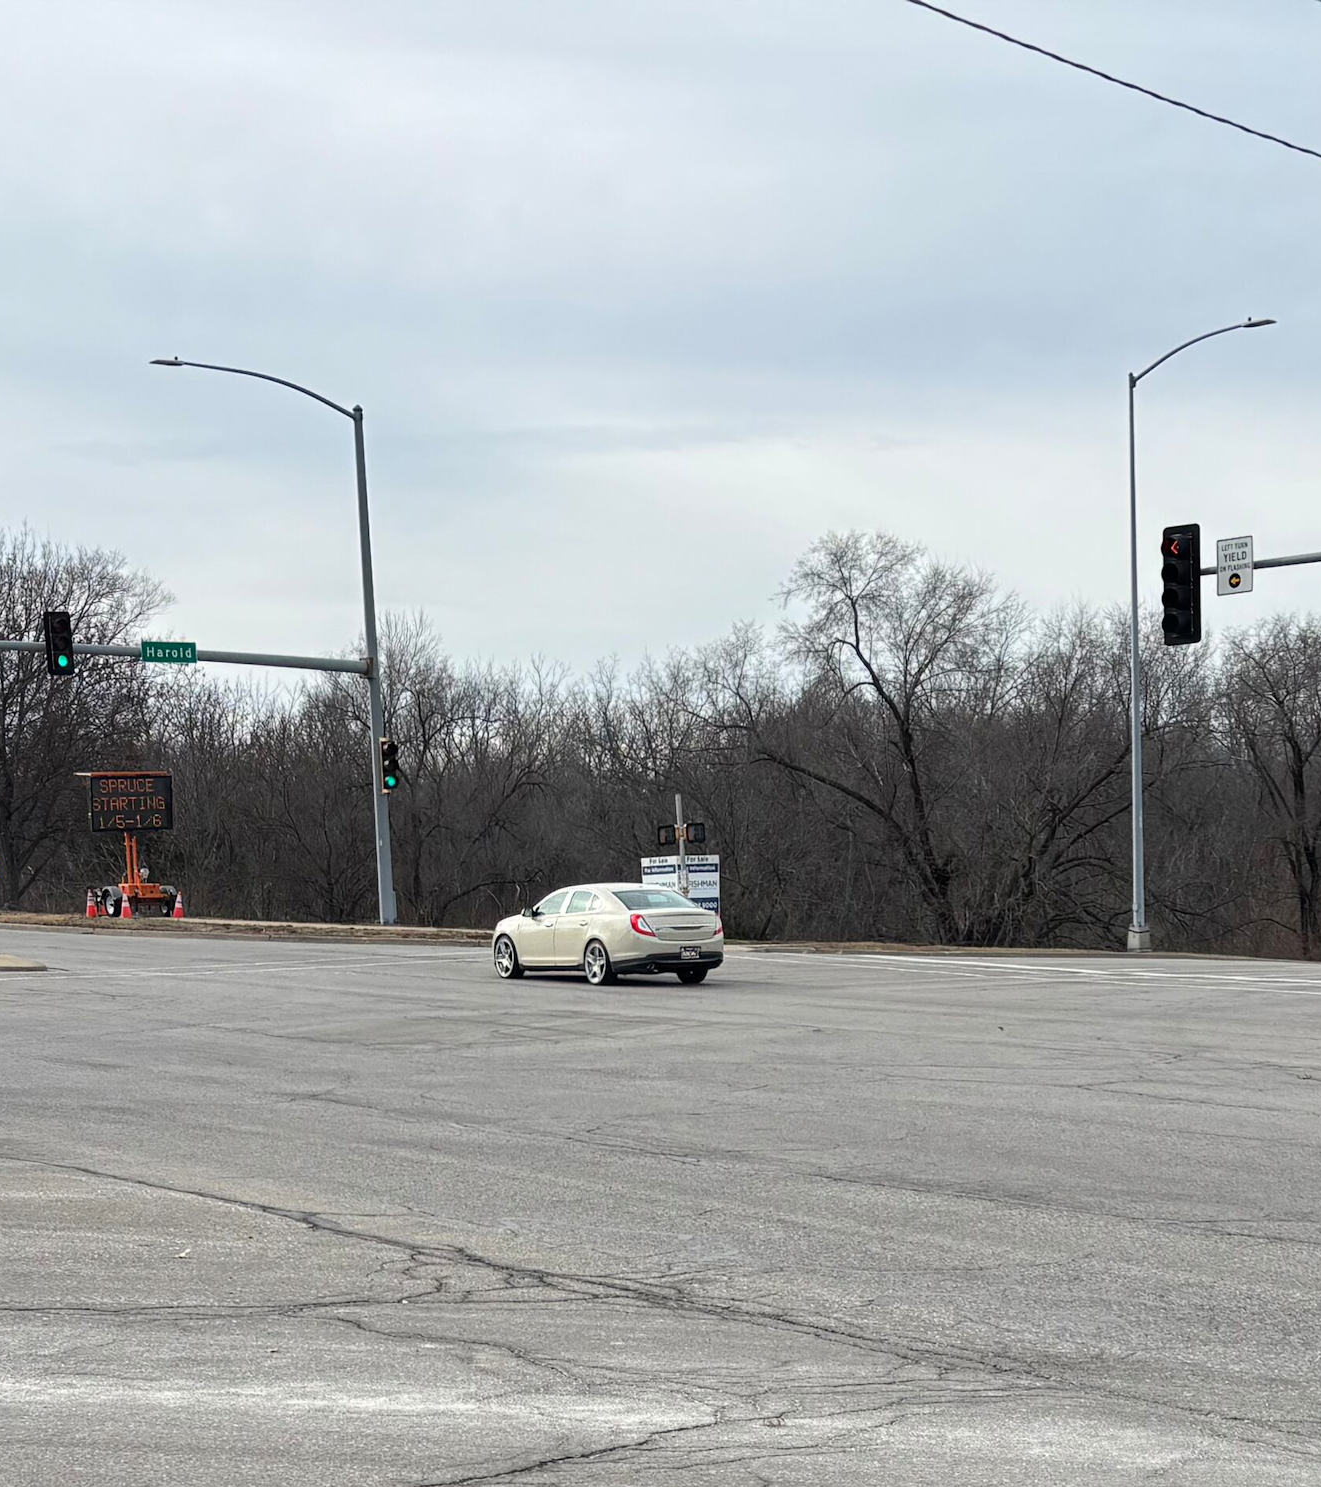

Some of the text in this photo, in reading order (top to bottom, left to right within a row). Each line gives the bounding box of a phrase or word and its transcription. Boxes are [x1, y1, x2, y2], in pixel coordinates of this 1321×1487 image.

[1223, 551, 1247, 563] YIELD
[146, 646, 192, 658] Harold
[99, 778, 155, 793] SPRUCE
[93, 796, 166, 811] STARTING
[99, 814, 163, 829] 1/5-1/6
